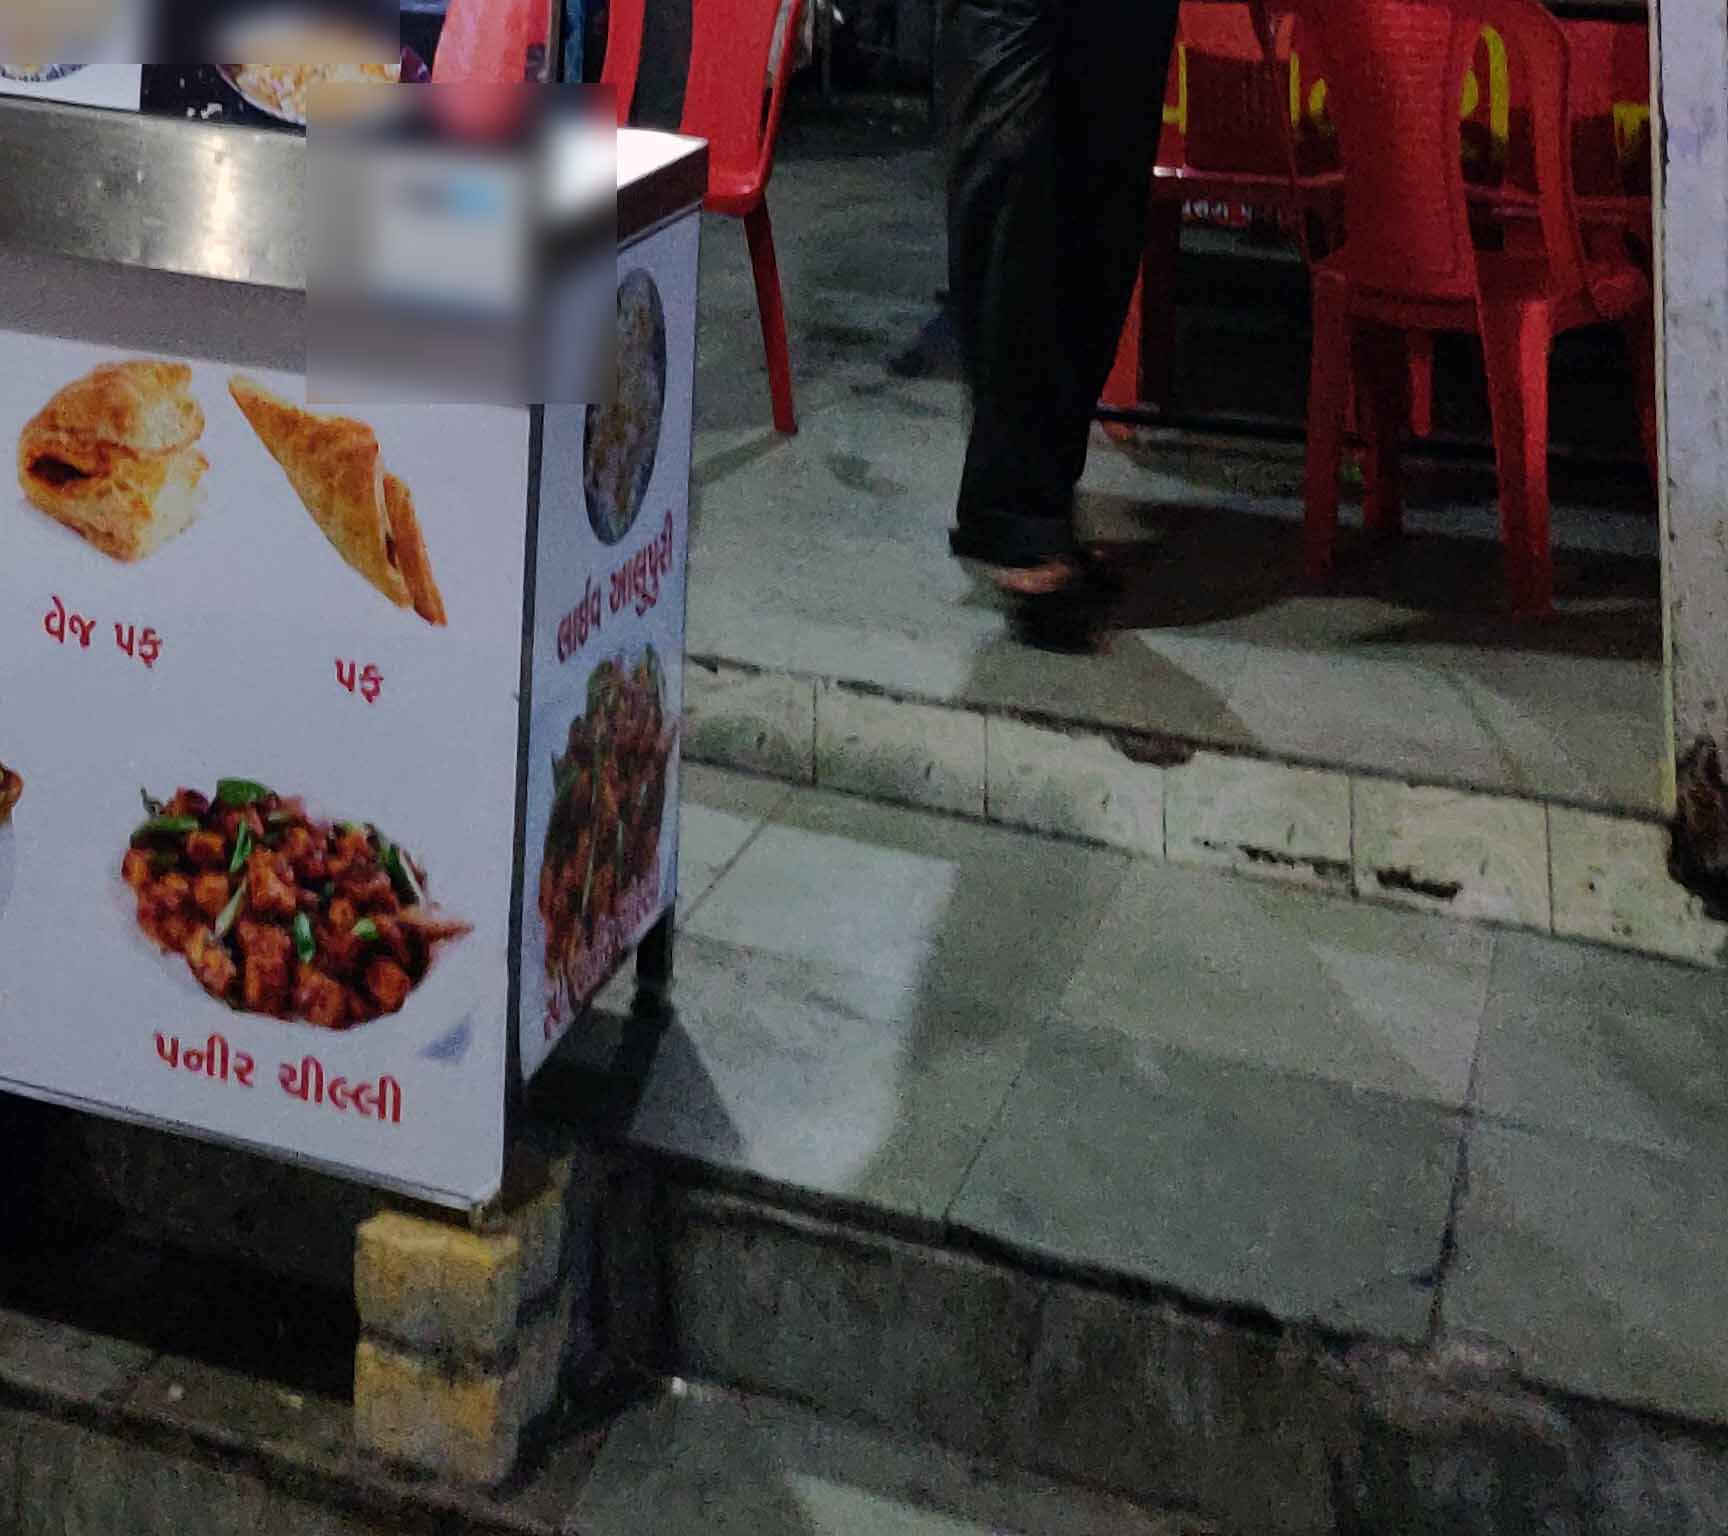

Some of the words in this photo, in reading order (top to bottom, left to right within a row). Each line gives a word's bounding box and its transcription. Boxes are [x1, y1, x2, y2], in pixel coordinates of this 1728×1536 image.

[42, 594, 97, 651] વેજ
[114, 623, 162, 666] પફ
[335, 658, 383, 705] પફ
[154, 1032, 256, 1087] પનીર
[278, 1055, 402, 1125] ચીલ્લી
